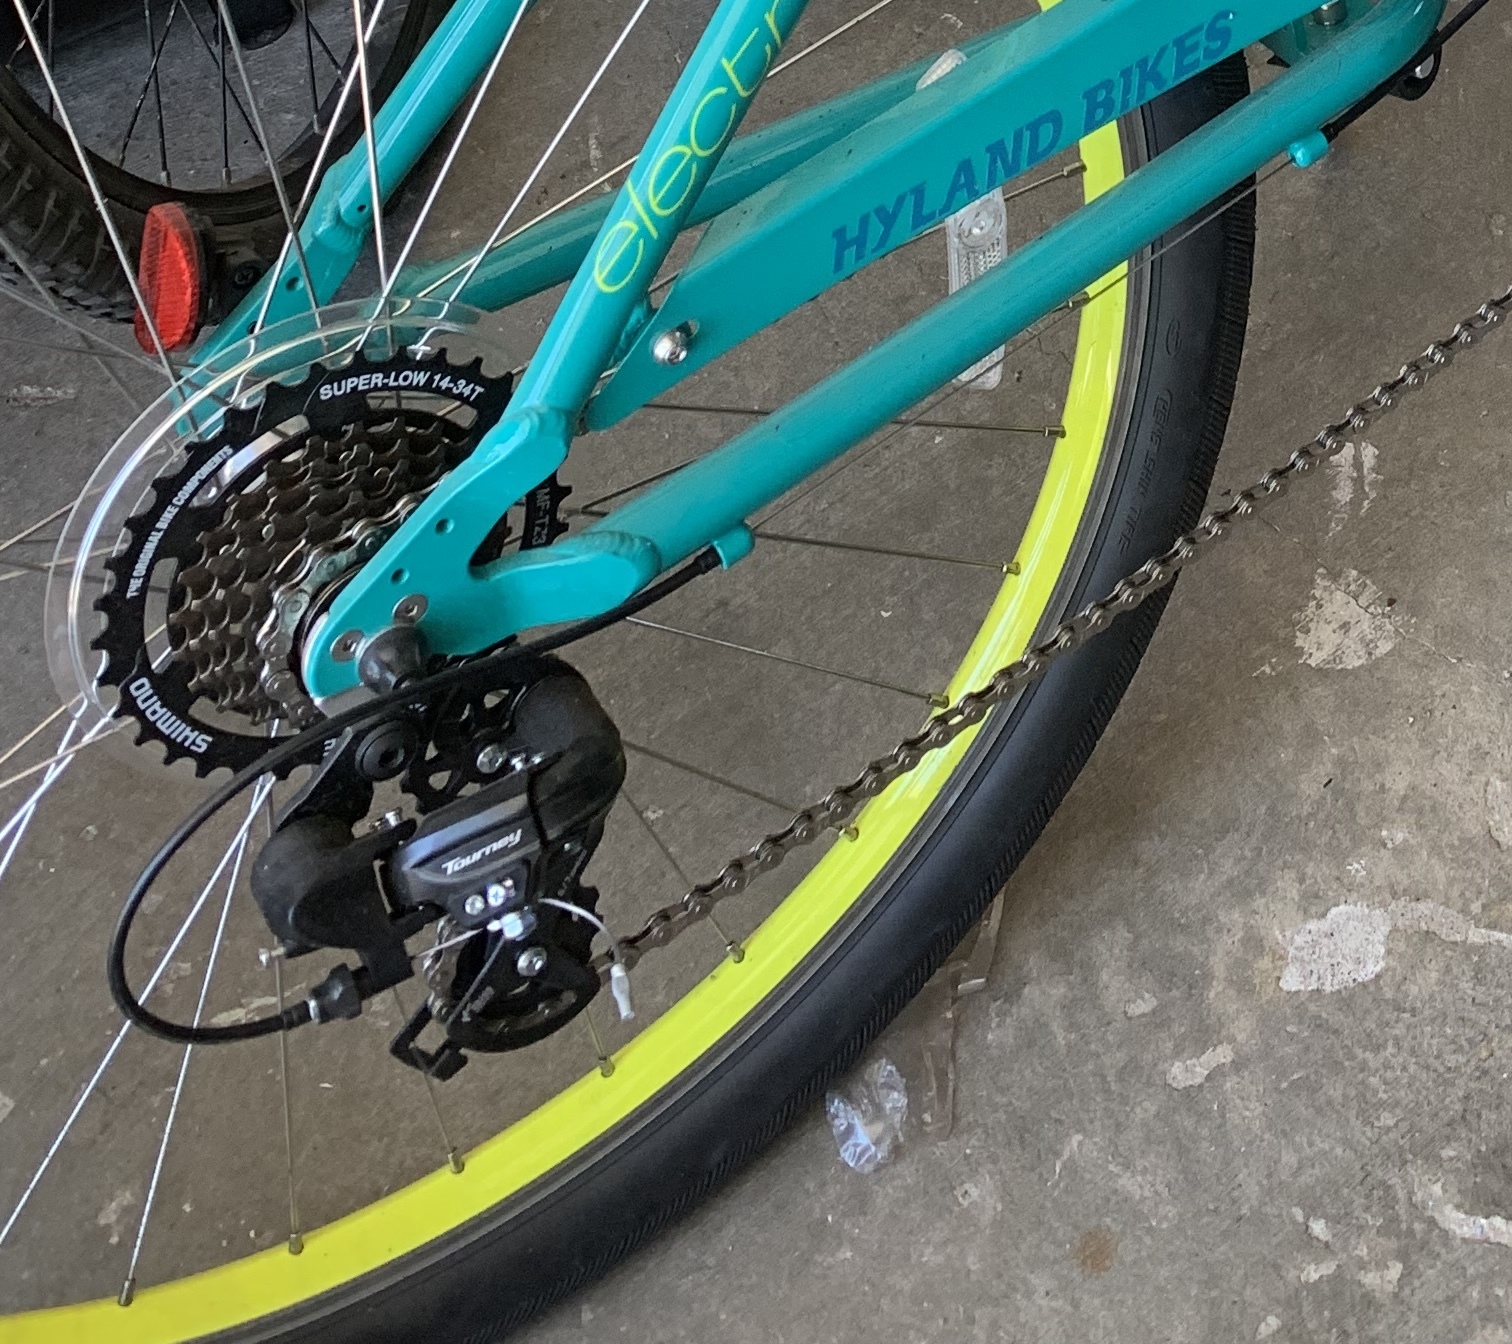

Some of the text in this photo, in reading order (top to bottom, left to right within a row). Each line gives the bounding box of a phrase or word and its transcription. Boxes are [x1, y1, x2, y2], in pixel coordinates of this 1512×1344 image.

[830, 10, 1235, 276] HYLAND BIKES
[318, 370, 486, 404] SUPER-LOW 14-34T
[132, 530, 163, 578] ORIGINAL
[155, 503, 180, 531] BIKE
[171, 444, 234, 506] COMPONENTS
[128, 675, 213, 755] SHIMANO
[441, 828, 525, 878] Tourney
